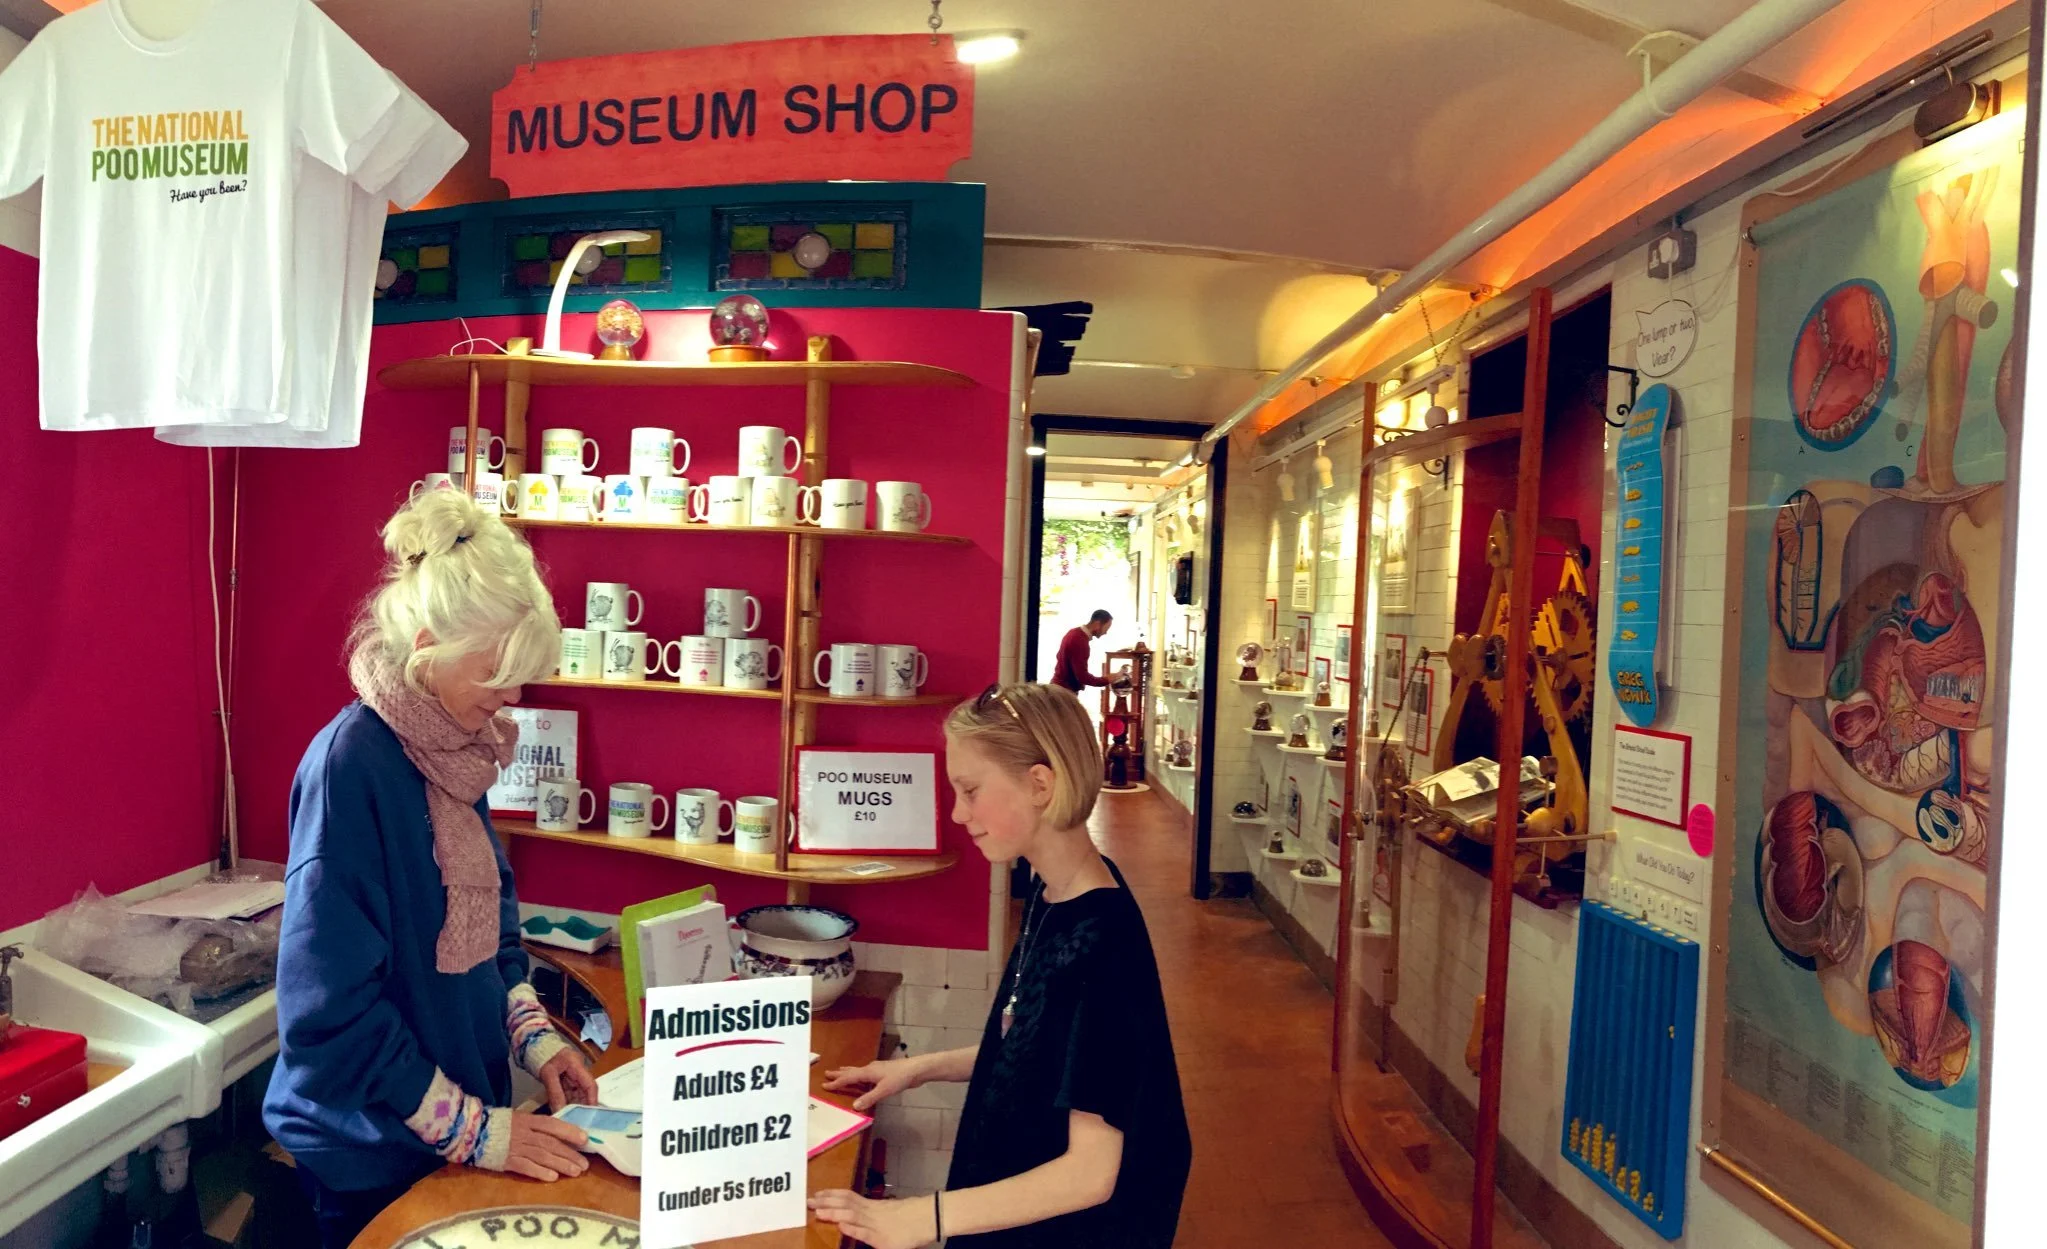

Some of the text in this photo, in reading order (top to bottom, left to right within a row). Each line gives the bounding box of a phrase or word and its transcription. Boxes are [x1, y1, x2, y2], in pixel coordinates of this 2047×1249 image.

[92, 110, 249, 148] THE NATIONAL
[507, 82, 959, 154] MUSEUM SHOP
[142, 142, 249, 180] MUSEUM
[170, 179, 248, 203] Have you been?
[1669, 323, 1677, 336] or
[536, 716, 551, 731] to
[817, 771, 913, 785] POO MUSEUM
[837, 791, 893, 806] MUGS
[854, 811, 876, 822] £10
[648, 999, 810, 1041] Admissions
[673, 1070, 746, 1101] Adults
[751, 1063, 779, 1090] £4
[661, 1113, 792, 1157] Children £2
[658, 1171, 791, 1211] (under 5s free)
